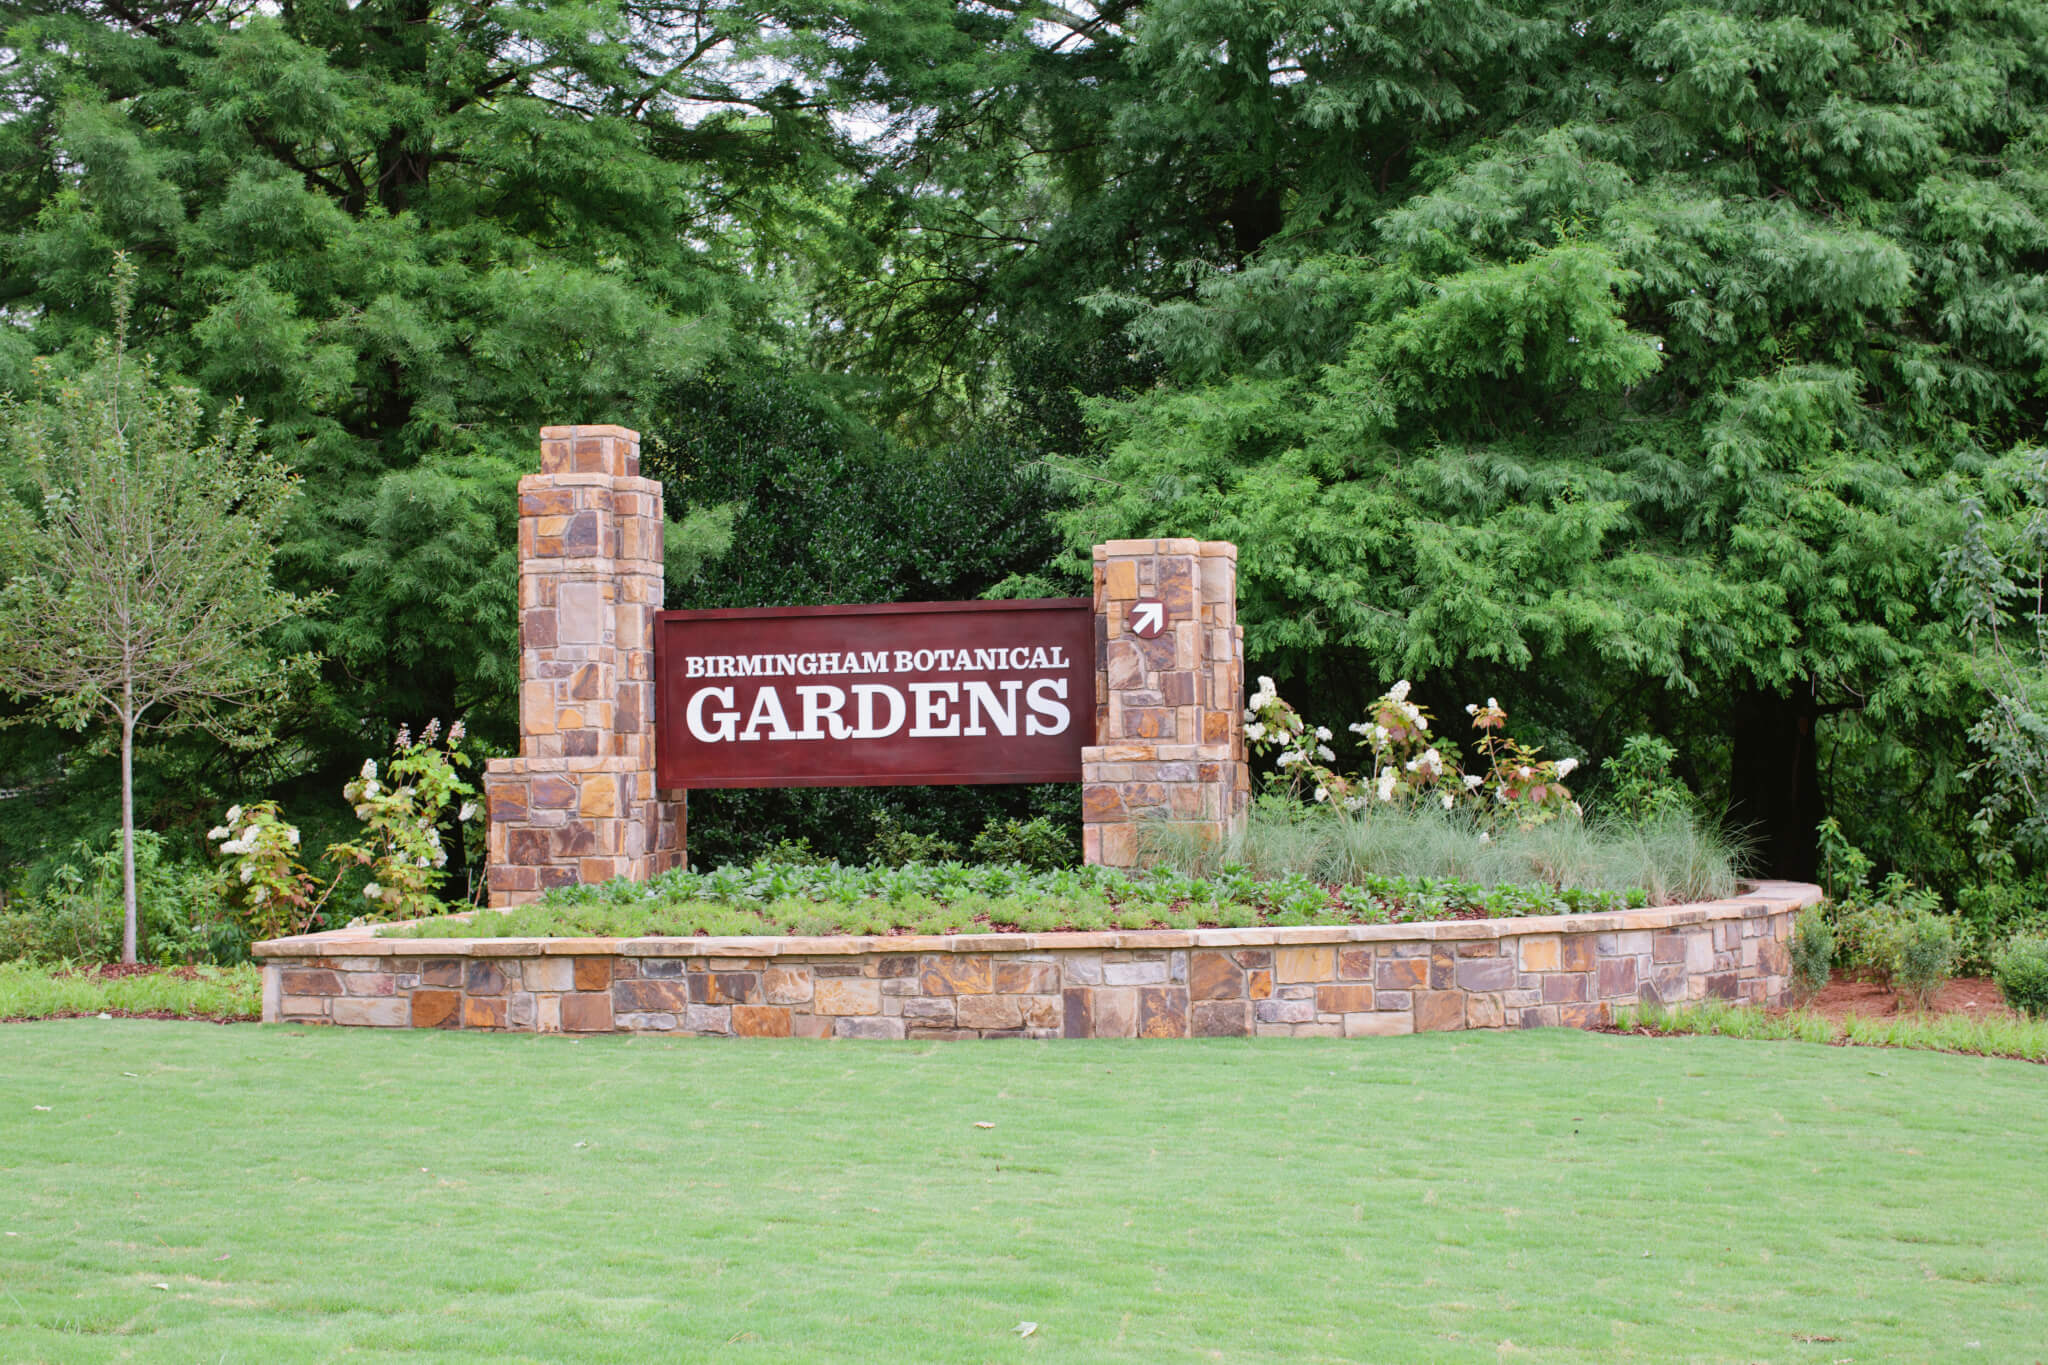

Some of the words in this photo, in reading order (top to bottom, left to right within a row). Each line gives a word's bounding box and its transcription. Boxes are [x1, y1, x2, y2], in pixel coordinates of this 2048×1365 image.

[685, 651, 889, 677] BIRMINGHAM
[894, 646, 1070, 672] BOTANICAL
[686, 678, 1071, 743] GARDENS
